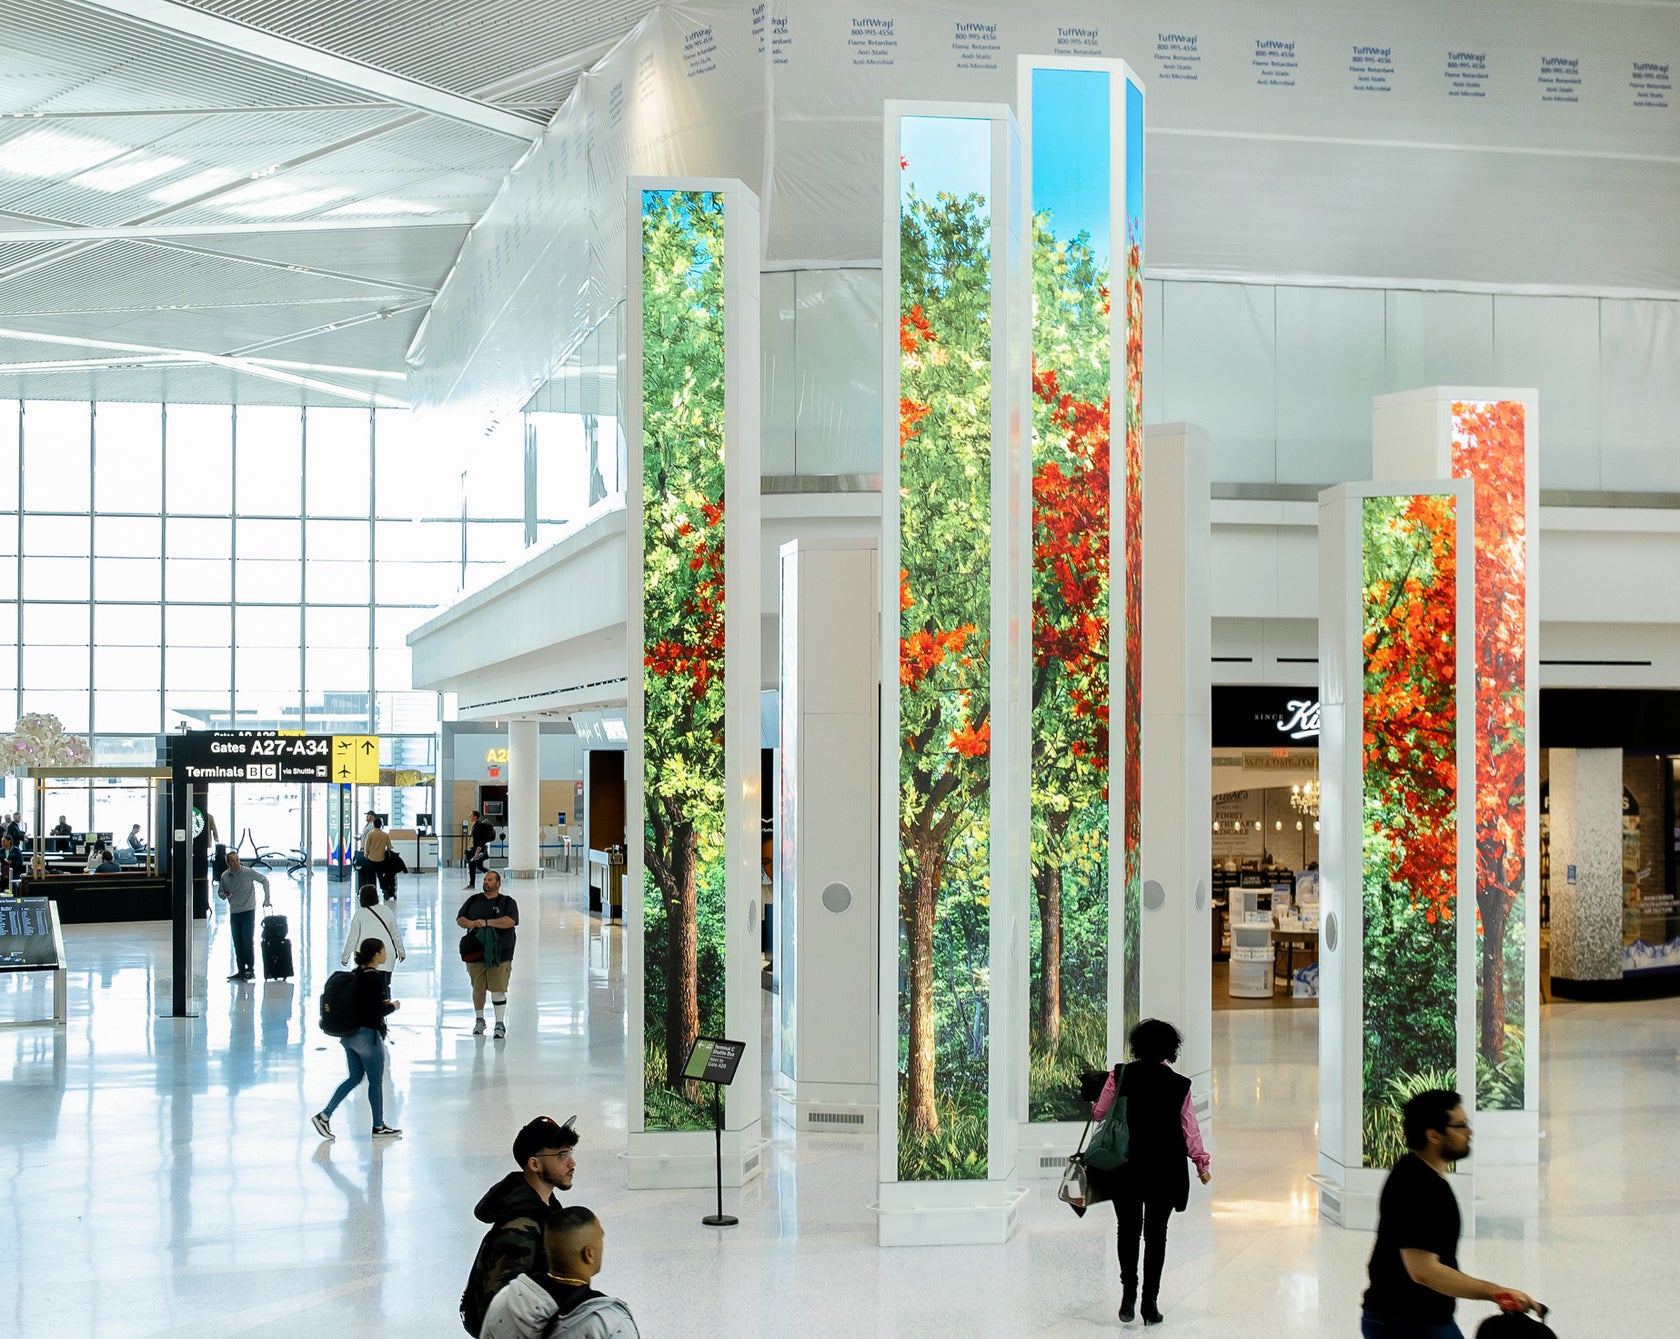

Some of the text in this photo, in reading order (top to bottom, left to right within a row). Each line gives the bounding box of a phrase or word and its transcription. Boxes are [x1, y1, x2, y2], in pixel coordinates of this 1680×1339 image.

[851, 18, 894, 28] TuffWrap
[955, 23, 997, 33] TuffWrap
[1057, 28, 1098, 38] TuffWrap
[1158, 33, 1197, 43] TuffWrap
[1256, 40, 1295, 50] TuffWrap
[1352, 46, 1391, 56] TuffWrap
[1447, 52, 1485, 62] TuffWrap
[1541, 57, 1579, 67] TuffWrap
[211, 740, 329, 756] Gates A27-A34
[185, 766, 245, 777] Terminals
[250, 767, 258, 777] B
[264, 767, 274, 777] C
[293, 767, 315, 775] Shuttle
